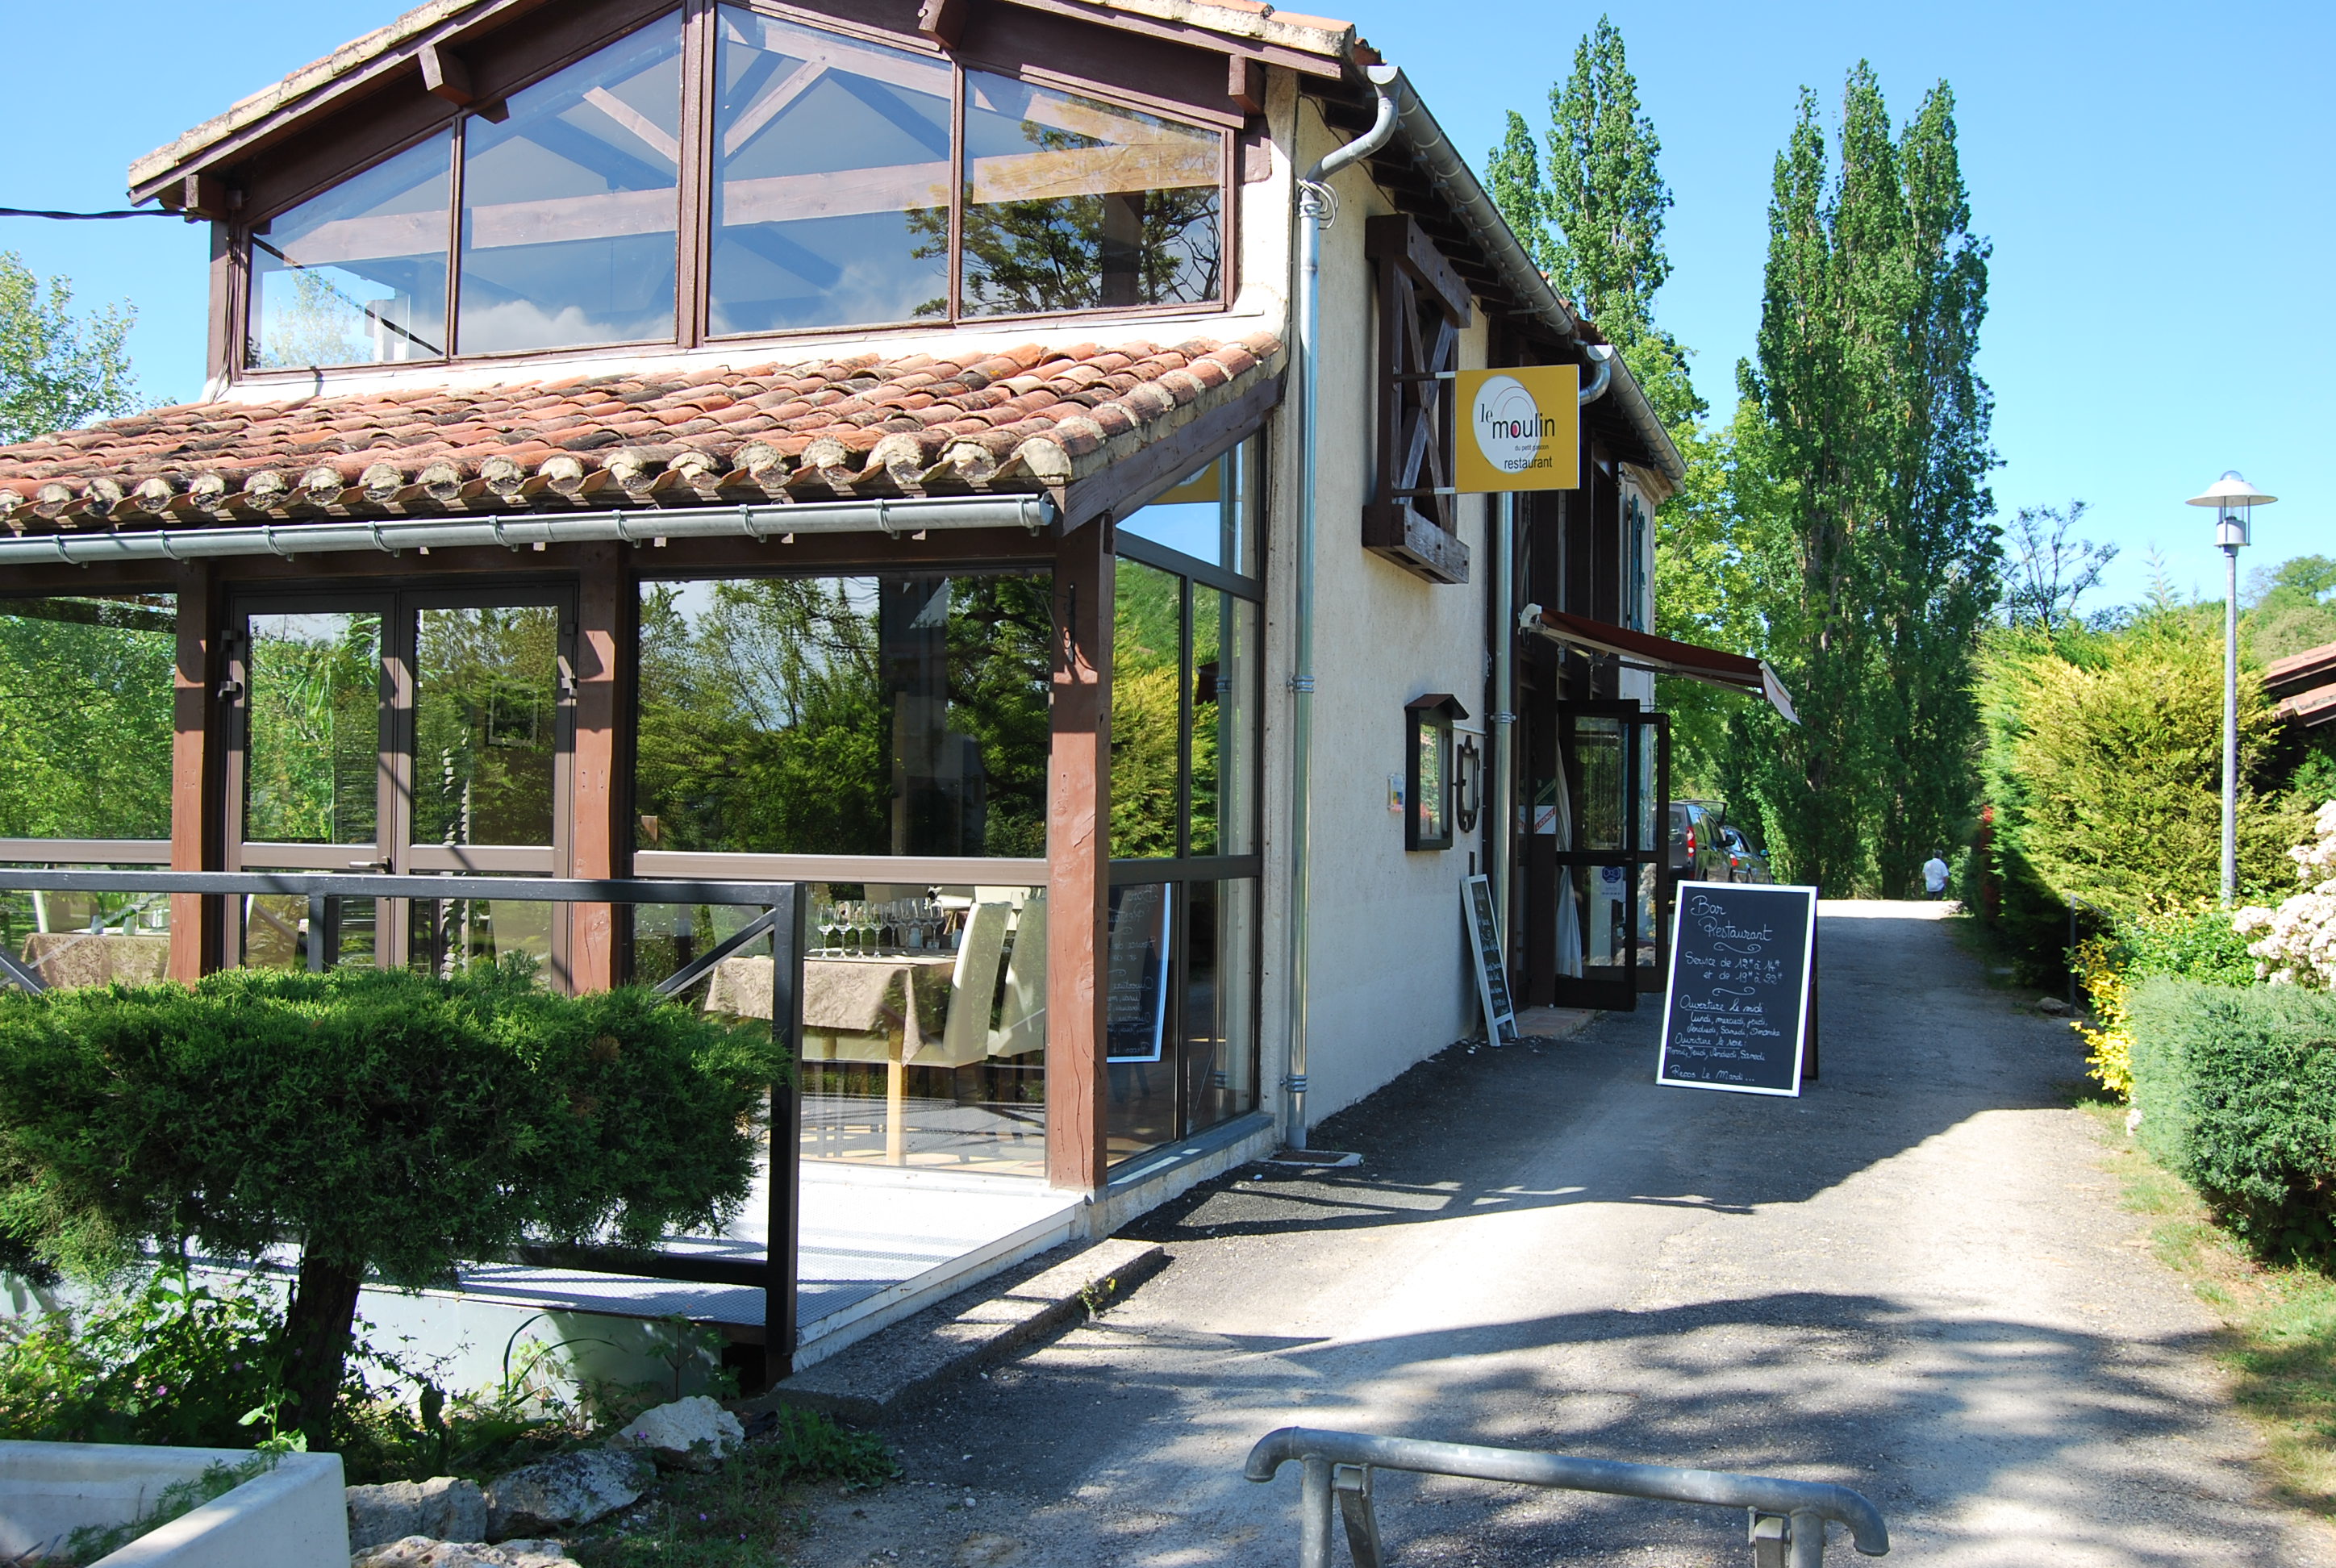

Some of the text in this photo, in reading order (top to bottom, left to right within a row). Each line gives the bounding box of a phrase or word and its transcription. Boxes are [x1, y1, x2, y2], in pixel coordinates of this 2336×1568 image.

[1480, 403, 1493, 423] le
[1492, 412, 1555, 439] moulin
[1504, 456, 1552, 469] restaurant
[1690, 895, 1726, 915] Bar
[1698, 915, 1773, 941] Restaurant
[1685, 951, 1716, 965] Service
[1721, 957, 1732, 968] de
[1704, 970, 1713, 979] et
[1719, 970, 1730, 980] de
[1679, 995, 1725, 1012] Ouverture
[1670, 1064, 1696, 1078] Repos
